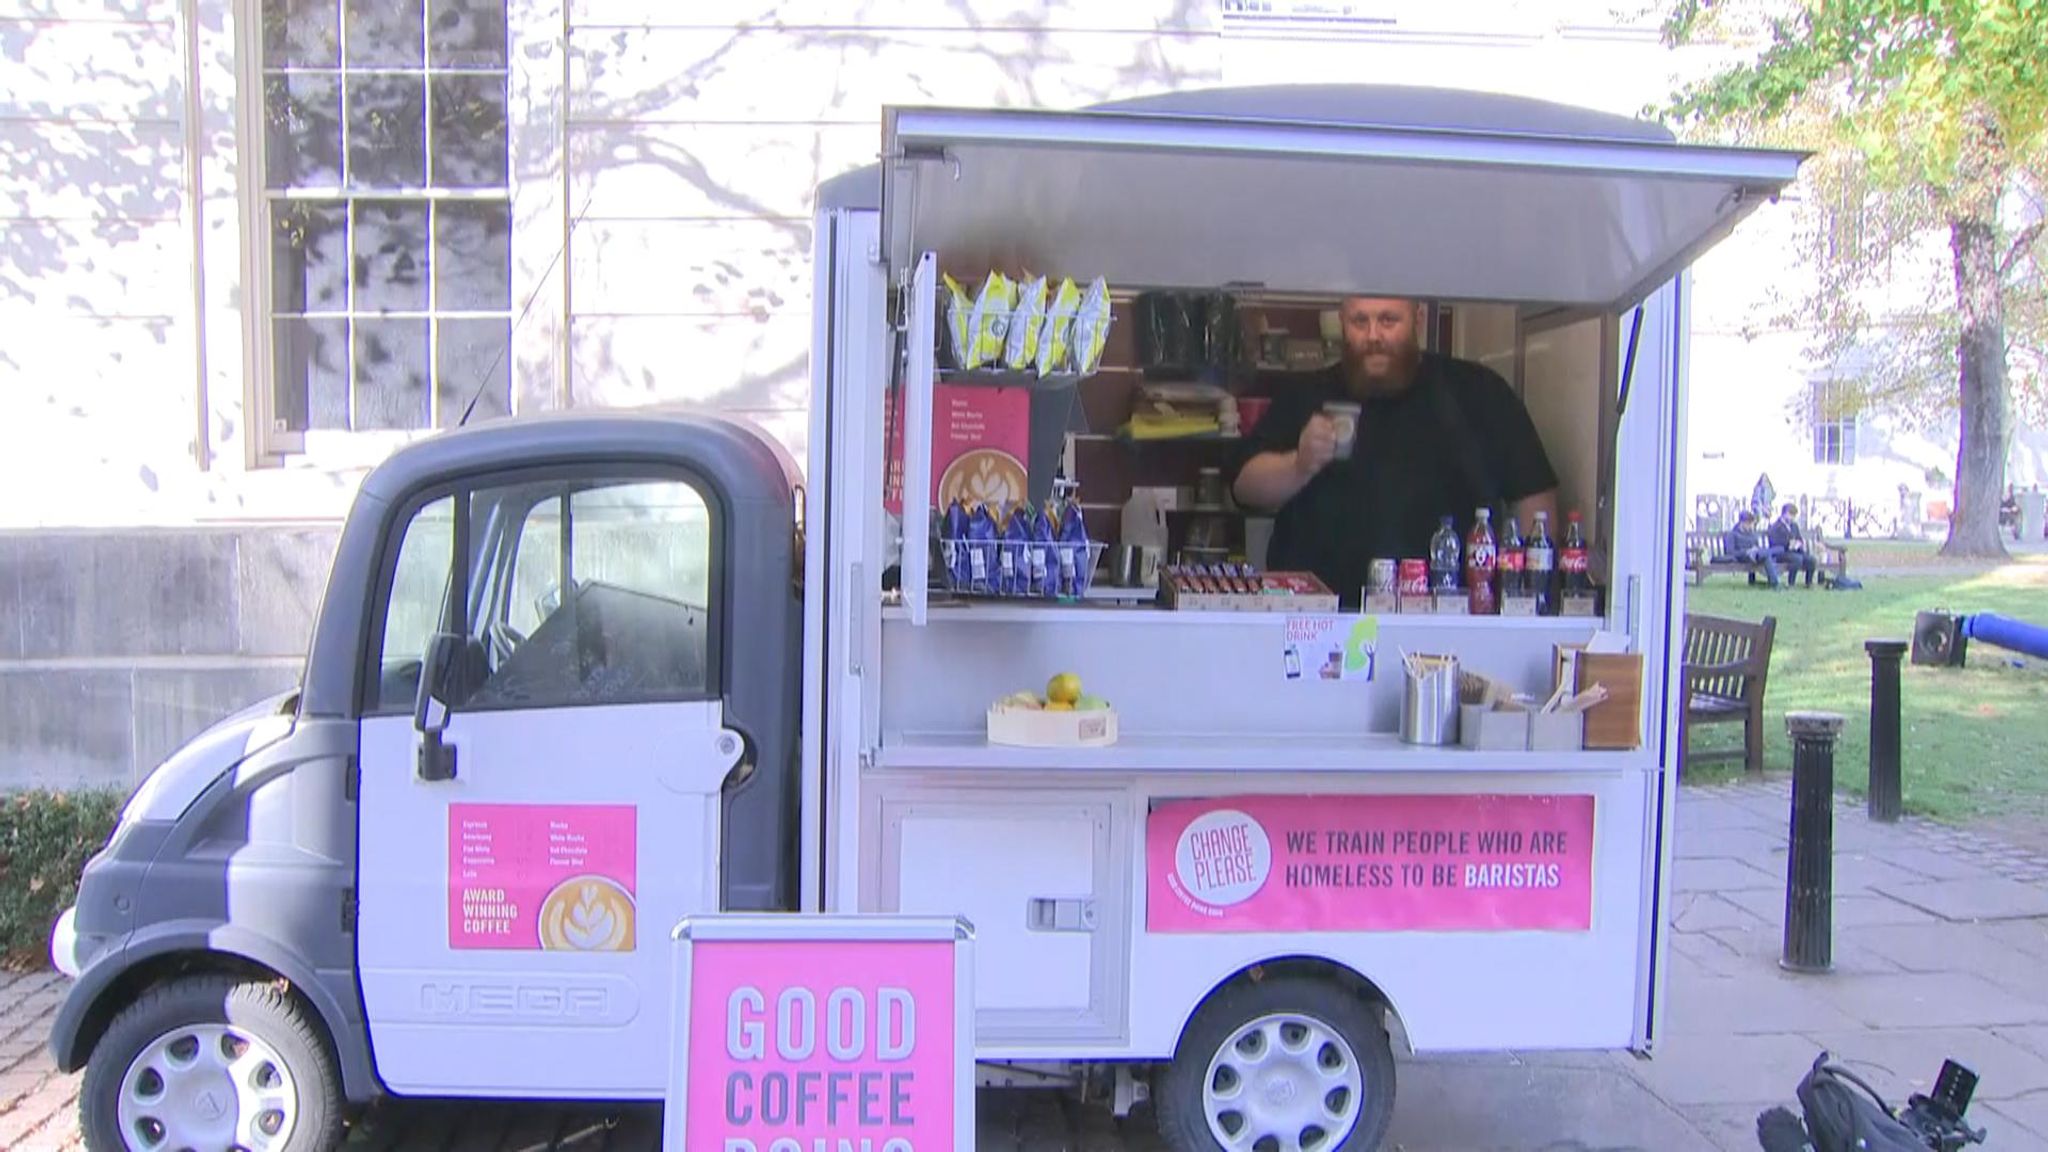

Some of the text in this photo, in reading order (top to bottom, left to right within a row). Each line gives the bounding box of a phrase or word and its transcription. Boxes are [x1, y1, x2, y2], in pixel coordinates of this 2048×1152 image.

[1287, 630, 1318, 641] DRINK
[1190, 823, 1252, 860] CHANGE
[1286, 830, 1567, 854] WE TRAIN PEOPLE WHO ARE
[1194, 854, 1257, 890] PLEASE
[1285, 863, 1560, 888] HOMELESS TO BE BARISTAS
[463, 888, 504, 901] AWARD
[463, 904, 518, 918] WINNING
[463, 919, 511, 934] COFFEE
[725, 986, 916, 1062] GOOD
[725, 1071, 914, 1126] COFFEE
